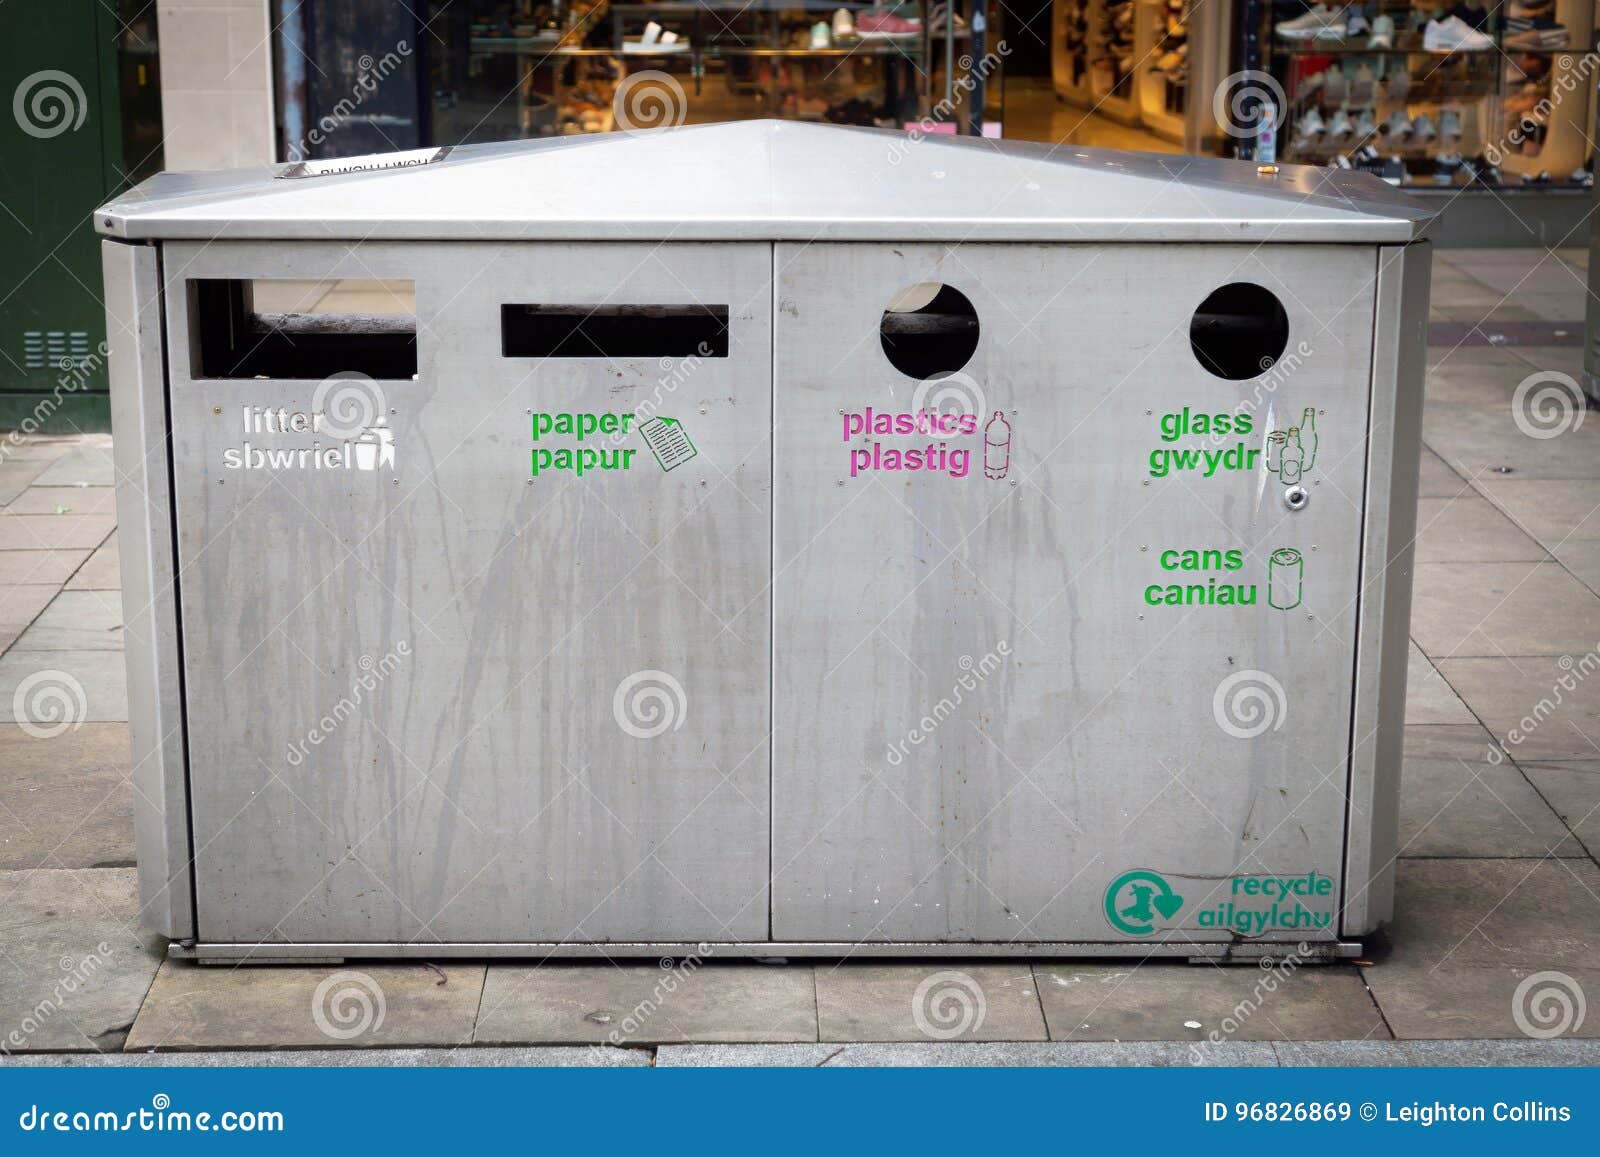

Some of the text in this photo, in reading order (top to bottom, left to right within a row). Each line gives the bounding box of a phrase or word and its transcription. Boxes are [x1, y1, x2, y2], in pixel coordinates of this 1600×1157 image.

[243, 405, 326, 433] litter
[532, 412, 636, 441] paper
[843, 406, 978, 442] plastics
[1160, 407, 1253, 442] glass
[223, 440, 351, 469] sbwriel
[531, 448, 637, 477] papur
[850, 442, 970, 478] plastig
[1149, 442, 1262, 478] gwydr
[1160, 549, 1244, 571] cans
[1144, 578, 1257, 606] caniau
[1231, 870, 1333, 903] recycle
[1197, 902, 1331, 933] ailgylchu
